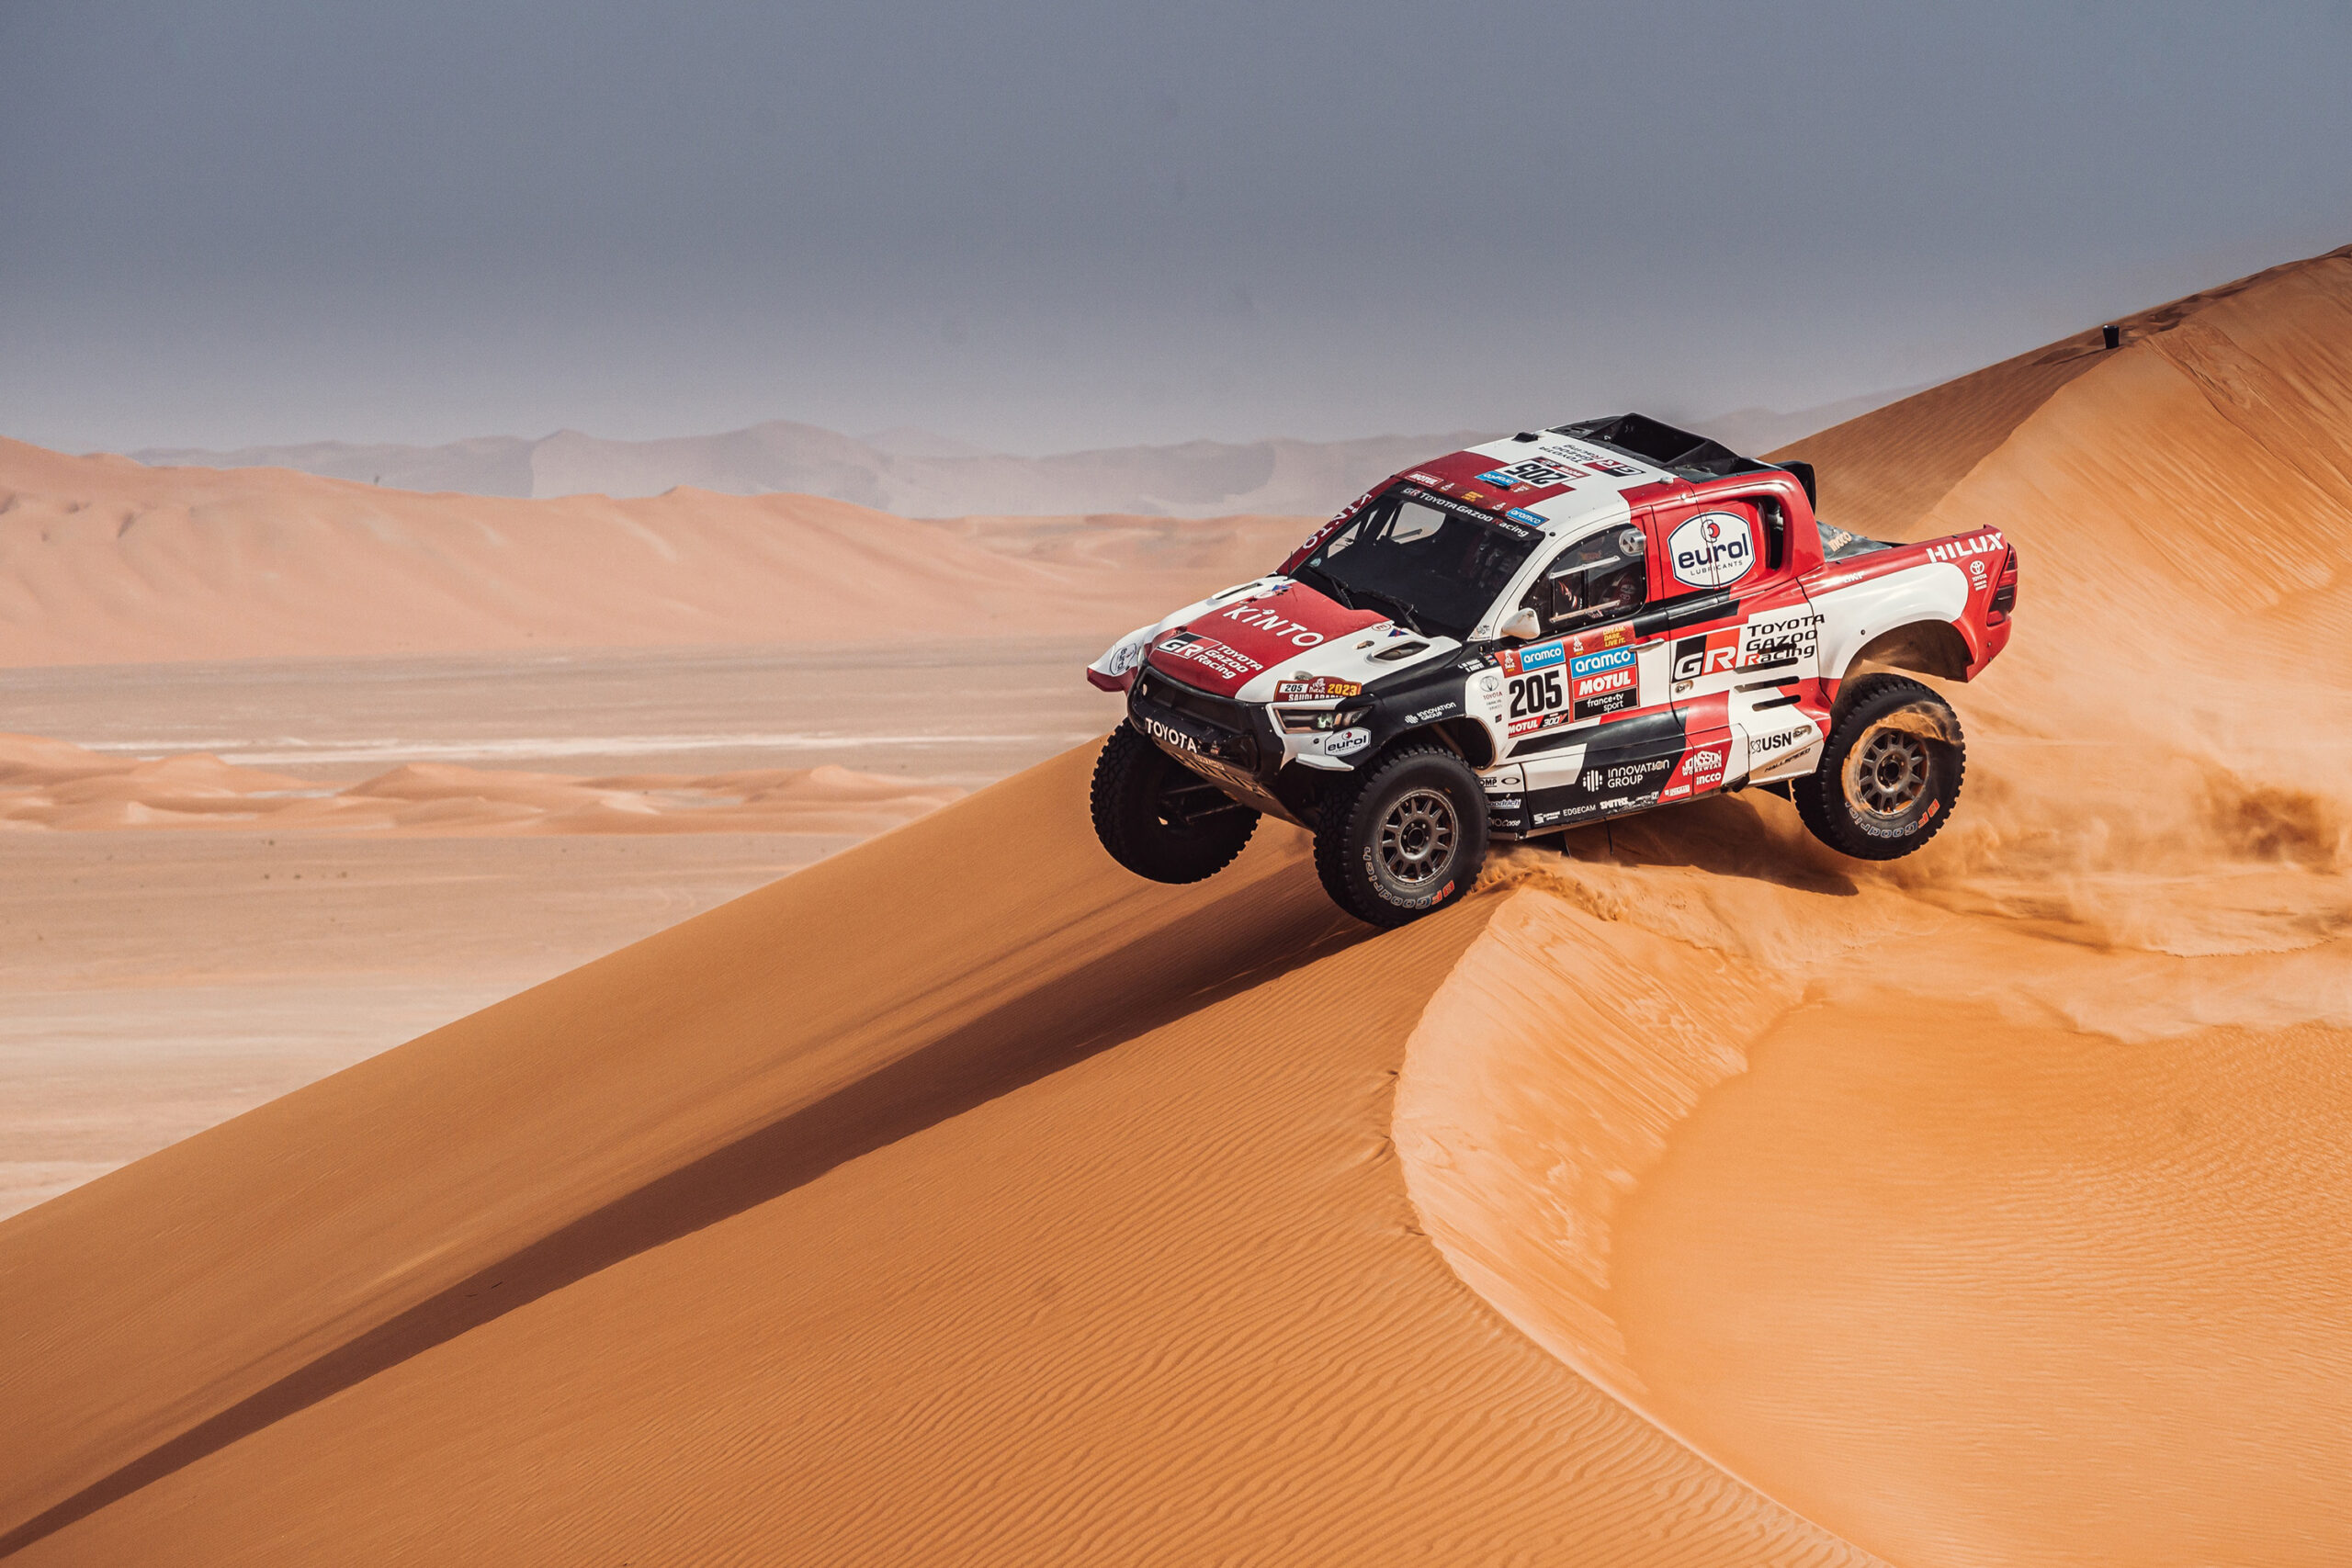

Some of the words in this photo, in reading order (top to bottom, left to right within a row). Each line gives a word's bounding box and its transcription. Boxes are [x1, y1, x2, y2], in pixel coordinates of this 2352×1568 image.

[1504, 463, 1568, 484] 205
[1403, 488, 1421, 496] GR
[1420, 491, 1456, 509] TOYOTA
[1455, 505, 1493, 522] GAZOO
[1492, 518, 1530, 537] Racing
[1510, 510, 1542, 525] aramco
[1679, 533, 1749, 569] eurol
[1926, 532, 2004, 563] HILUX
[1690, 560, 1743, 576] LUBRICANTS
[1747, 614, 1826, 637] TOYOTA
[1159, 639, 1204, 657] GR
[1746, 629, 1818, 652] GAZOO
[1193, 654, 1237, 679] Racing
[1204, 649, 1249, 672] GAZOO
[1217, 645, 1263, 671] TOYOTA
[1523, 648, 1562, 663] aramco
[1575, 650, 1631, 672] aramco
[1674, 646, 1736, 681] GR
[1745, 645, 1815, 666] Racing
[1327, 683, 1358, 697] 2023
[1509, 670, 1562, 718] 205
[1578, 671, 1631, 695] MOTUL
[1603, 700, 1623, 713] sport
[1145, 716, 1197, 753] TOYOTA
[1508, 719, 1539, 735] MOTUL
[1543, 713, 1567, 727] 300V
[1328, 735, 1367, 752] eurol
[1762, 732, 1792, 750] USN
[1682, 750, 1722, 772] JONSSON
[1682, 763, 1722, 776] WORKWEAR
[1608, 774, 1643, 788] GROUP
[1696, 773, 1722, 785] incco
[1563, 805, 1596, 816] EDGECAM
[1363, 846, 1455, 908] BFGoodrich
